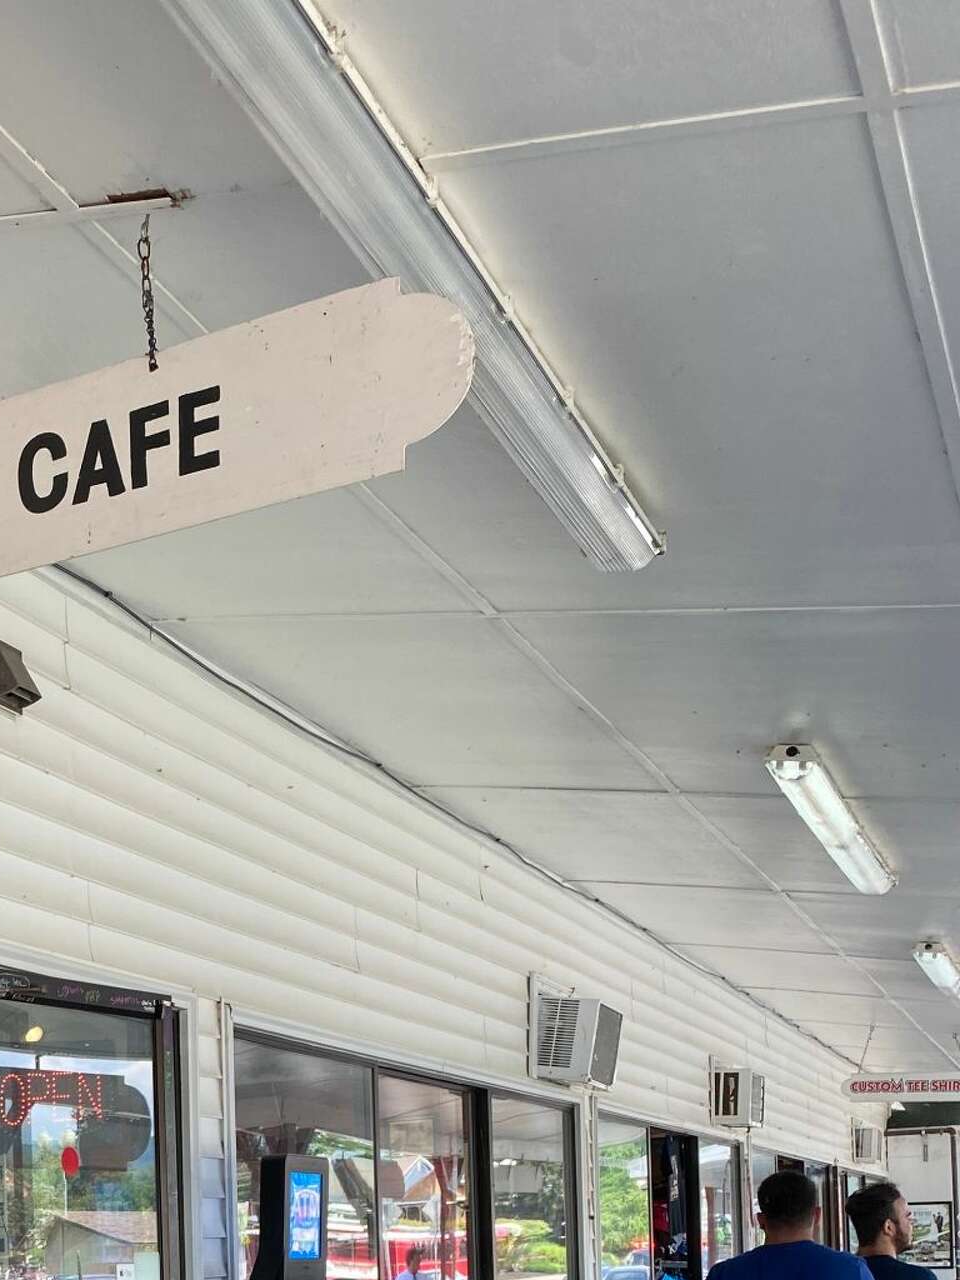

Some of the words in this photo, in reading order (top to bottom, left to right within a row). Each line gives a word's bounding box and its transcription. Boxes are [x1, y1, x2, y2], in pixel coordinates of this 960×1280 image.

[17, 384, 221, 514] CAFE
[0, 1071, 104, 1127] OPEN
[849, 1077, 904, 1094] CUSTOM
[905, 1079, 929, 1093] TEE
